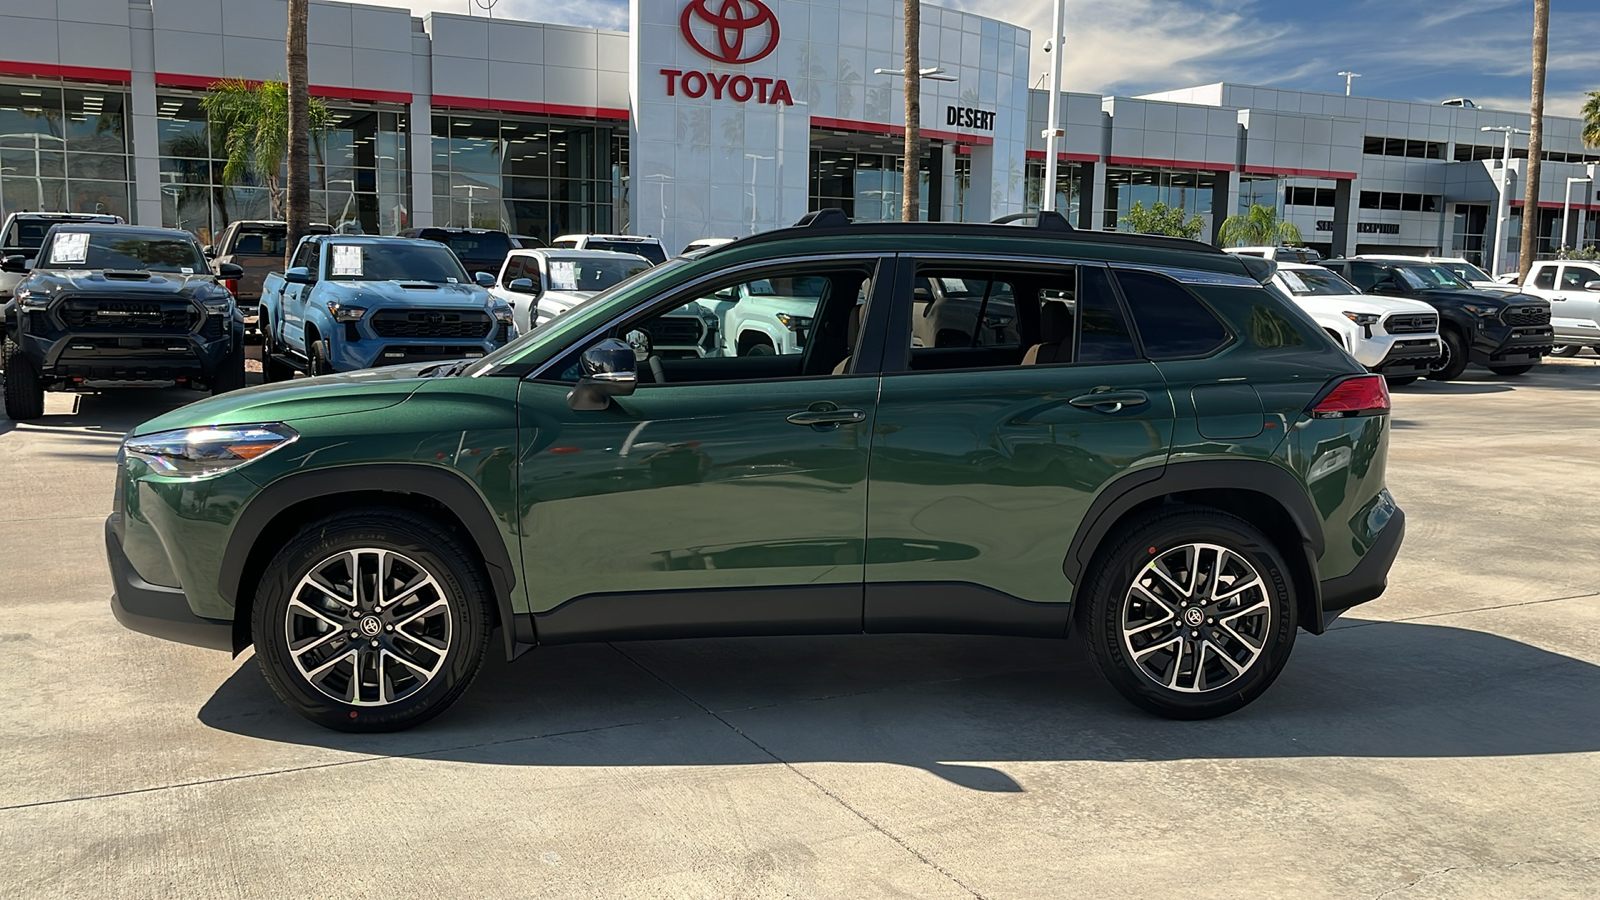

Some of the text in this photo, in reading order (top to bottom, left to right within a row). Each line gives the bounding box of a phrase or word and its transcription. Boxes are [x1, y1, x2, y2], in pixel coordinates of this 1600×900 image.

[660, 69, 794, 106] TOYOTA
[946, 106, 996, 131] DESERT
[1105, 596, 1127, 669] ASSURANCE
[1269, 567, 1290, 644] GOODYEAR
